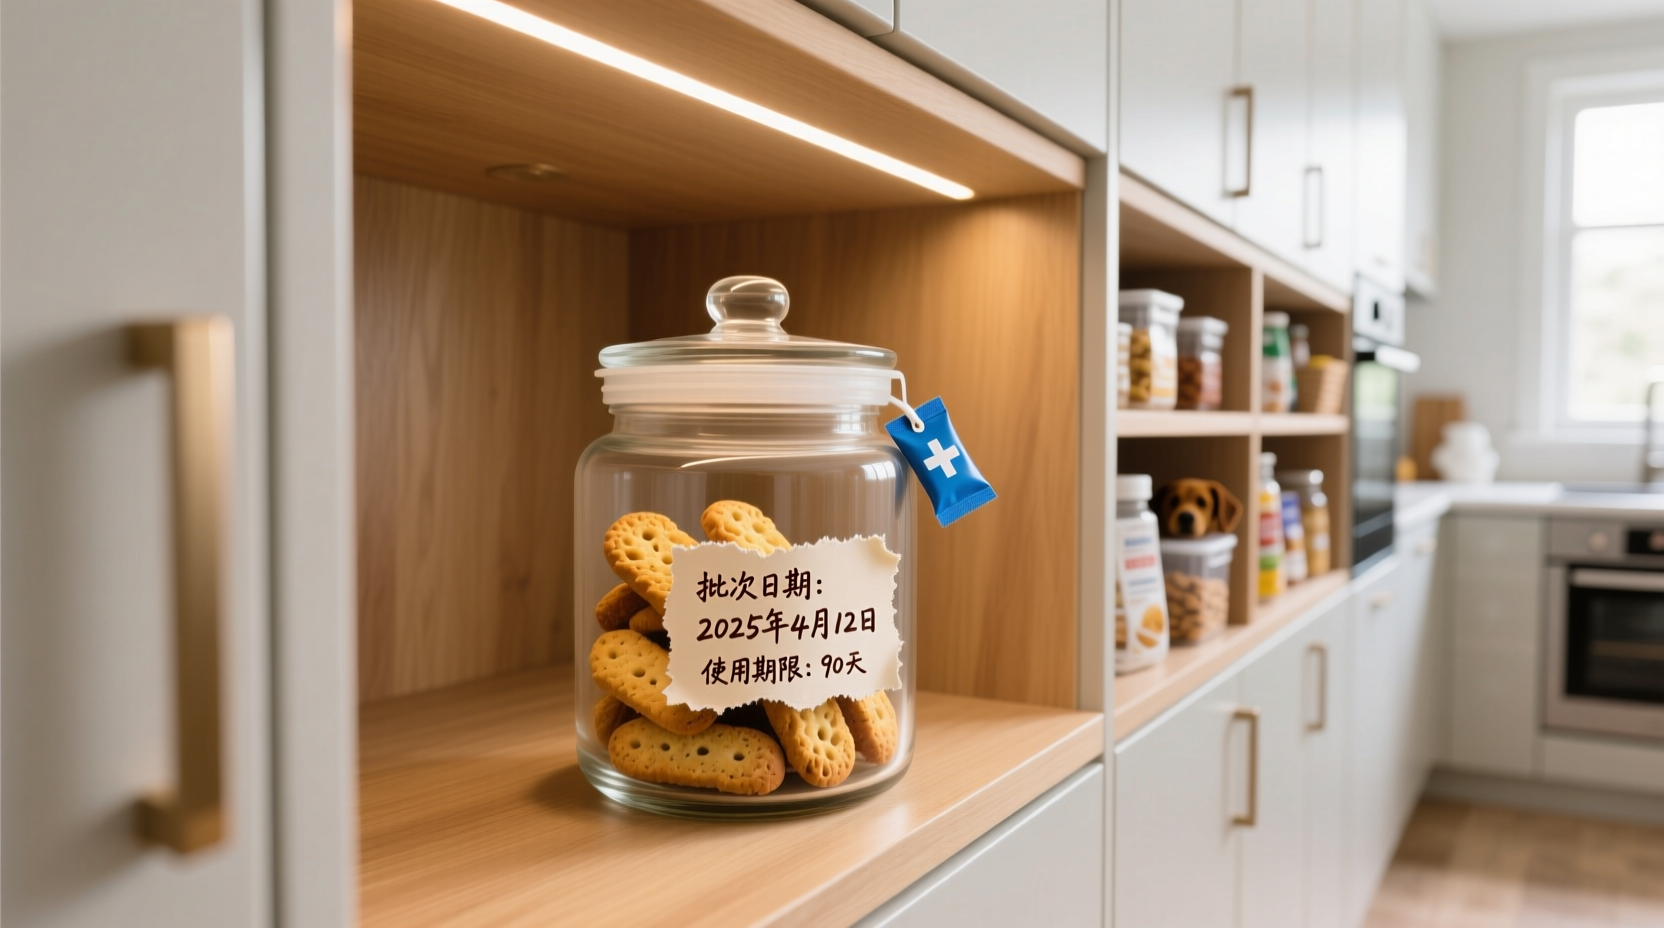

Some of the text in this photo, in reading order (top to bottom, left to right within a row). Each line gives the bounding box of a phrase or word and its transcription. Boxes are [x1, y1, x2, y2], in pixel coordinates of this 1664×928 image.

[696, 567, 823, 603] 批次日期：
[696, 607, 876, 645] 2025年4月12日
